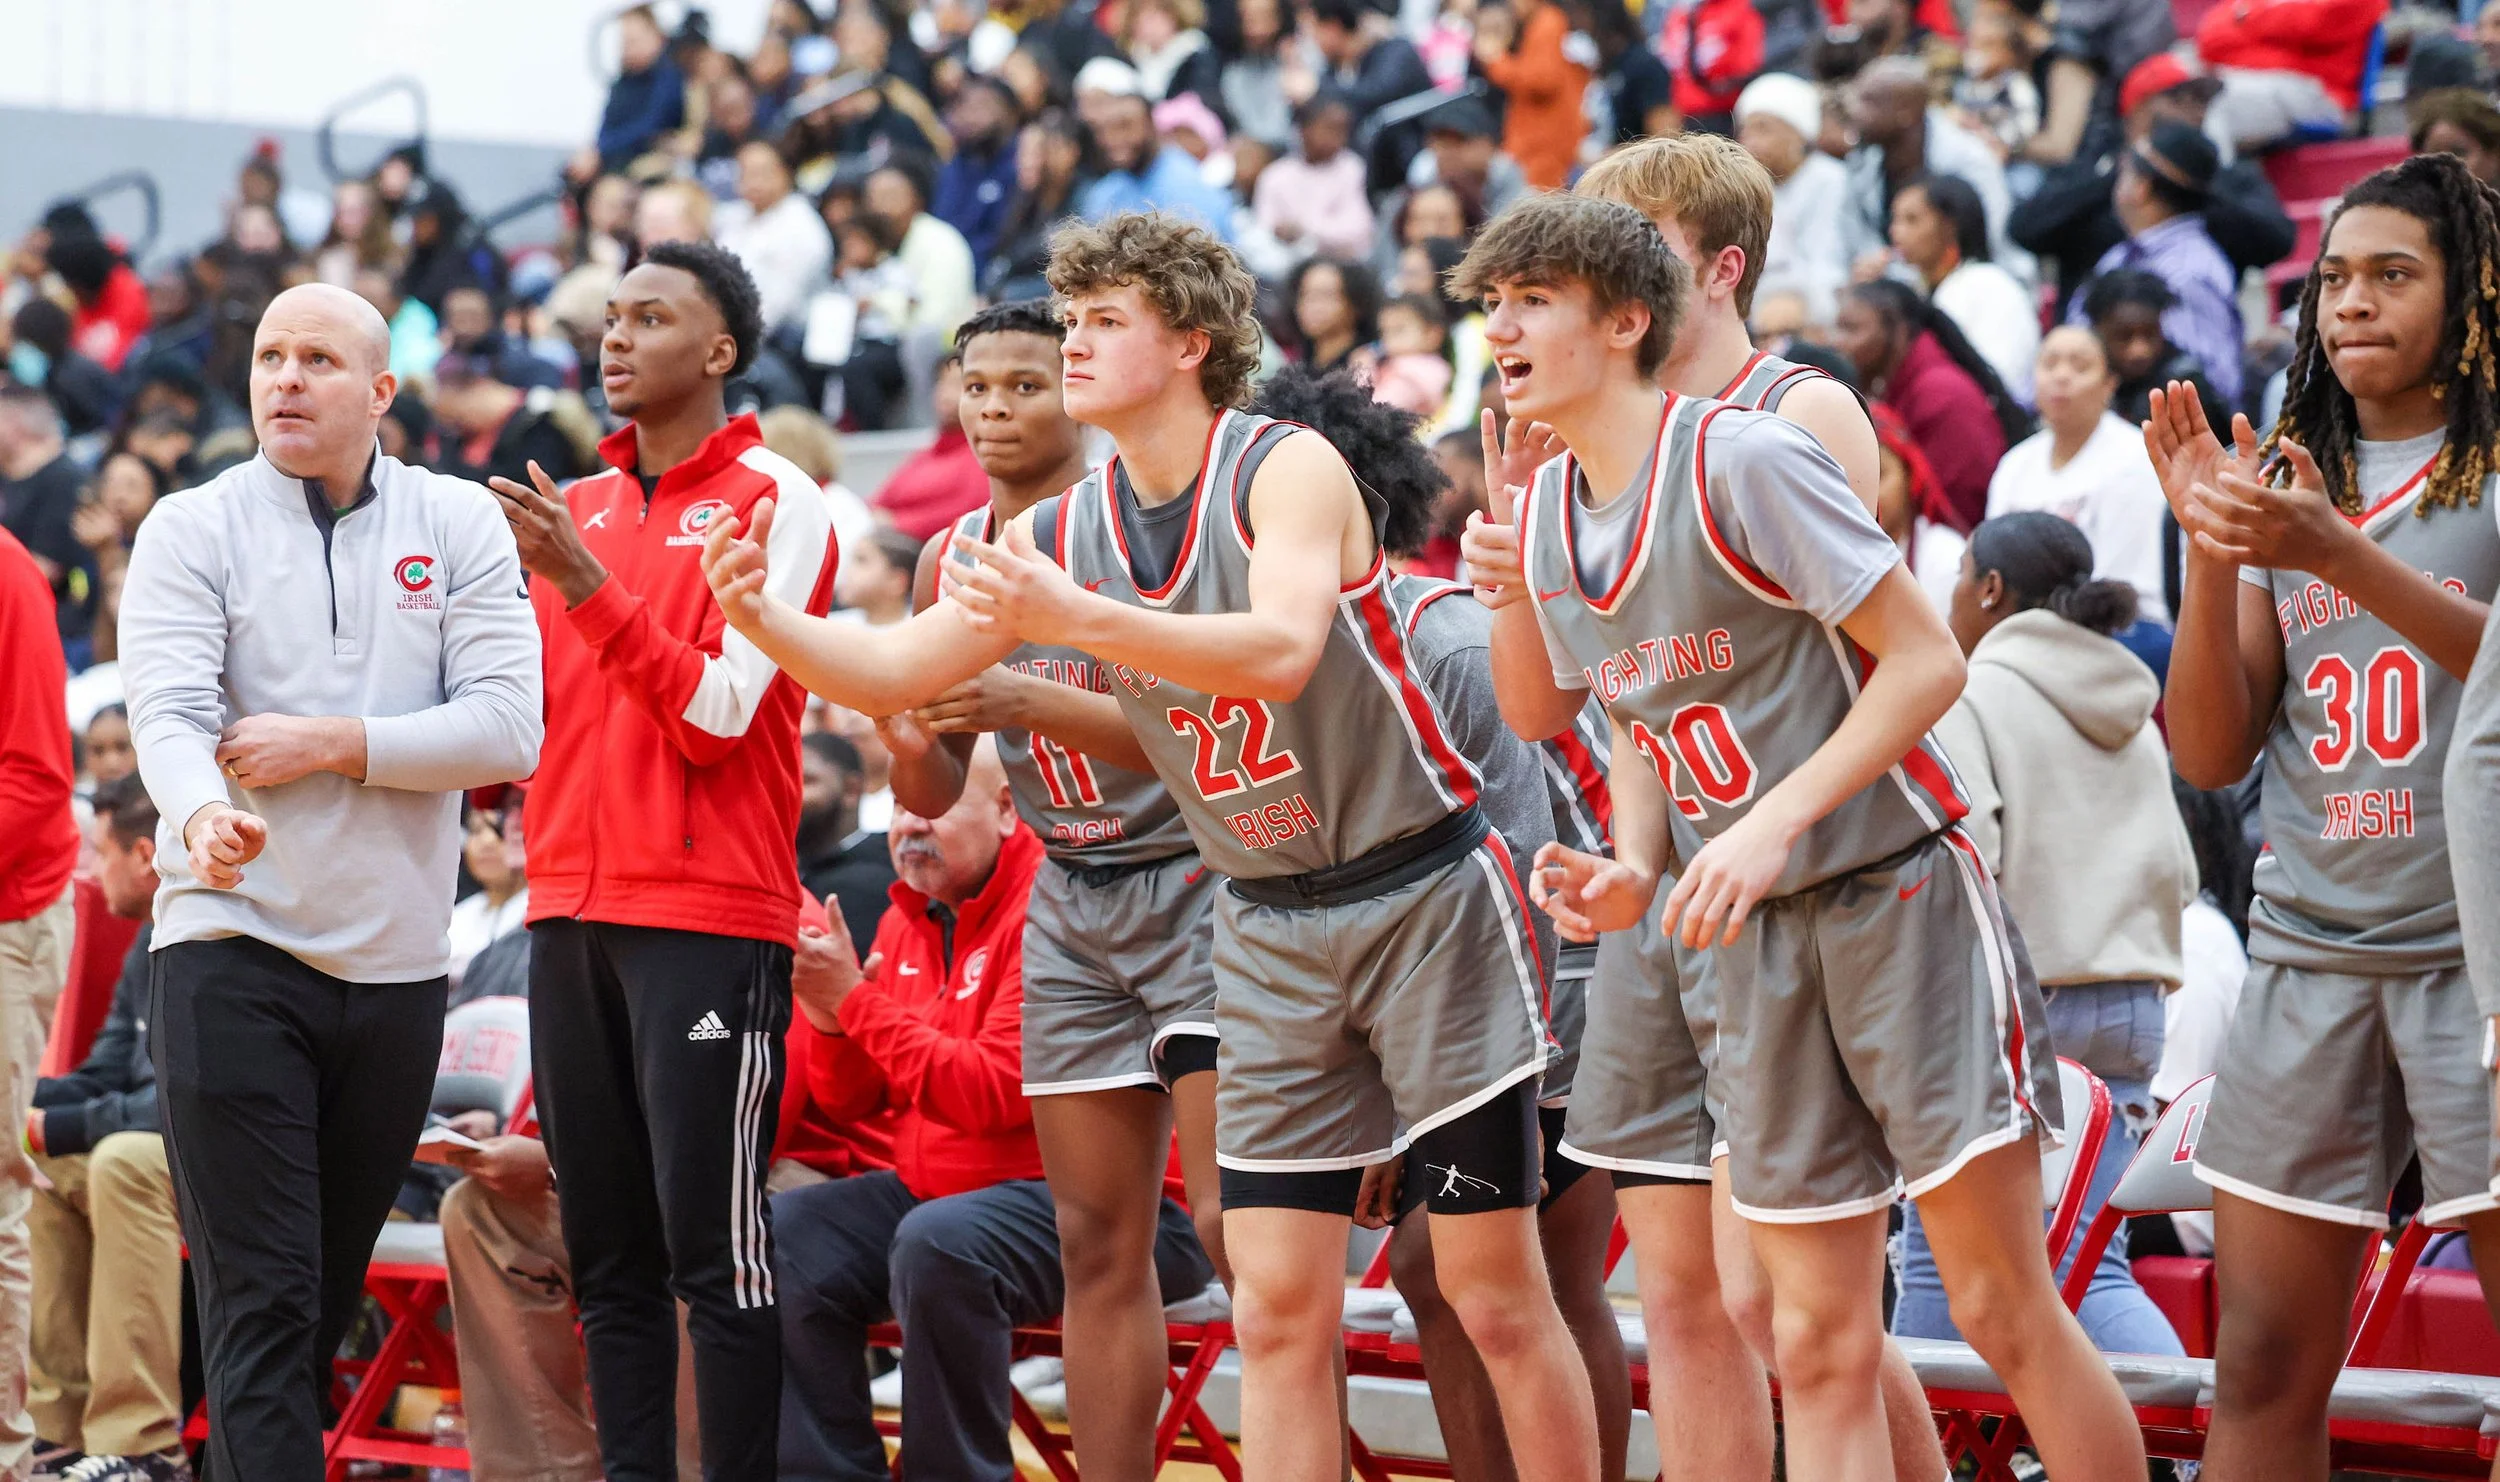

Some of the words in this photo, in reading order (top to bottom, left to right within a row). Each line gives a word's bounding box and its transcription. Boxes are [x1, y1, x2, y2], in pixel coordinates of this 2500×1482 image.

[396, 602, 441, 610] BASKETBALL
[402, 593, 433, 603] IRISH
[1584, 627, 1735, 708] IGHTING
[2304, 645, 2428, 773] 30
[1166, 695, 1303, 802] 22
[1225, 793, 1320, 851] IRISH
[2320, 787, 2415, 840] IRISH
[688, 1029, 731, 1041] adidas
